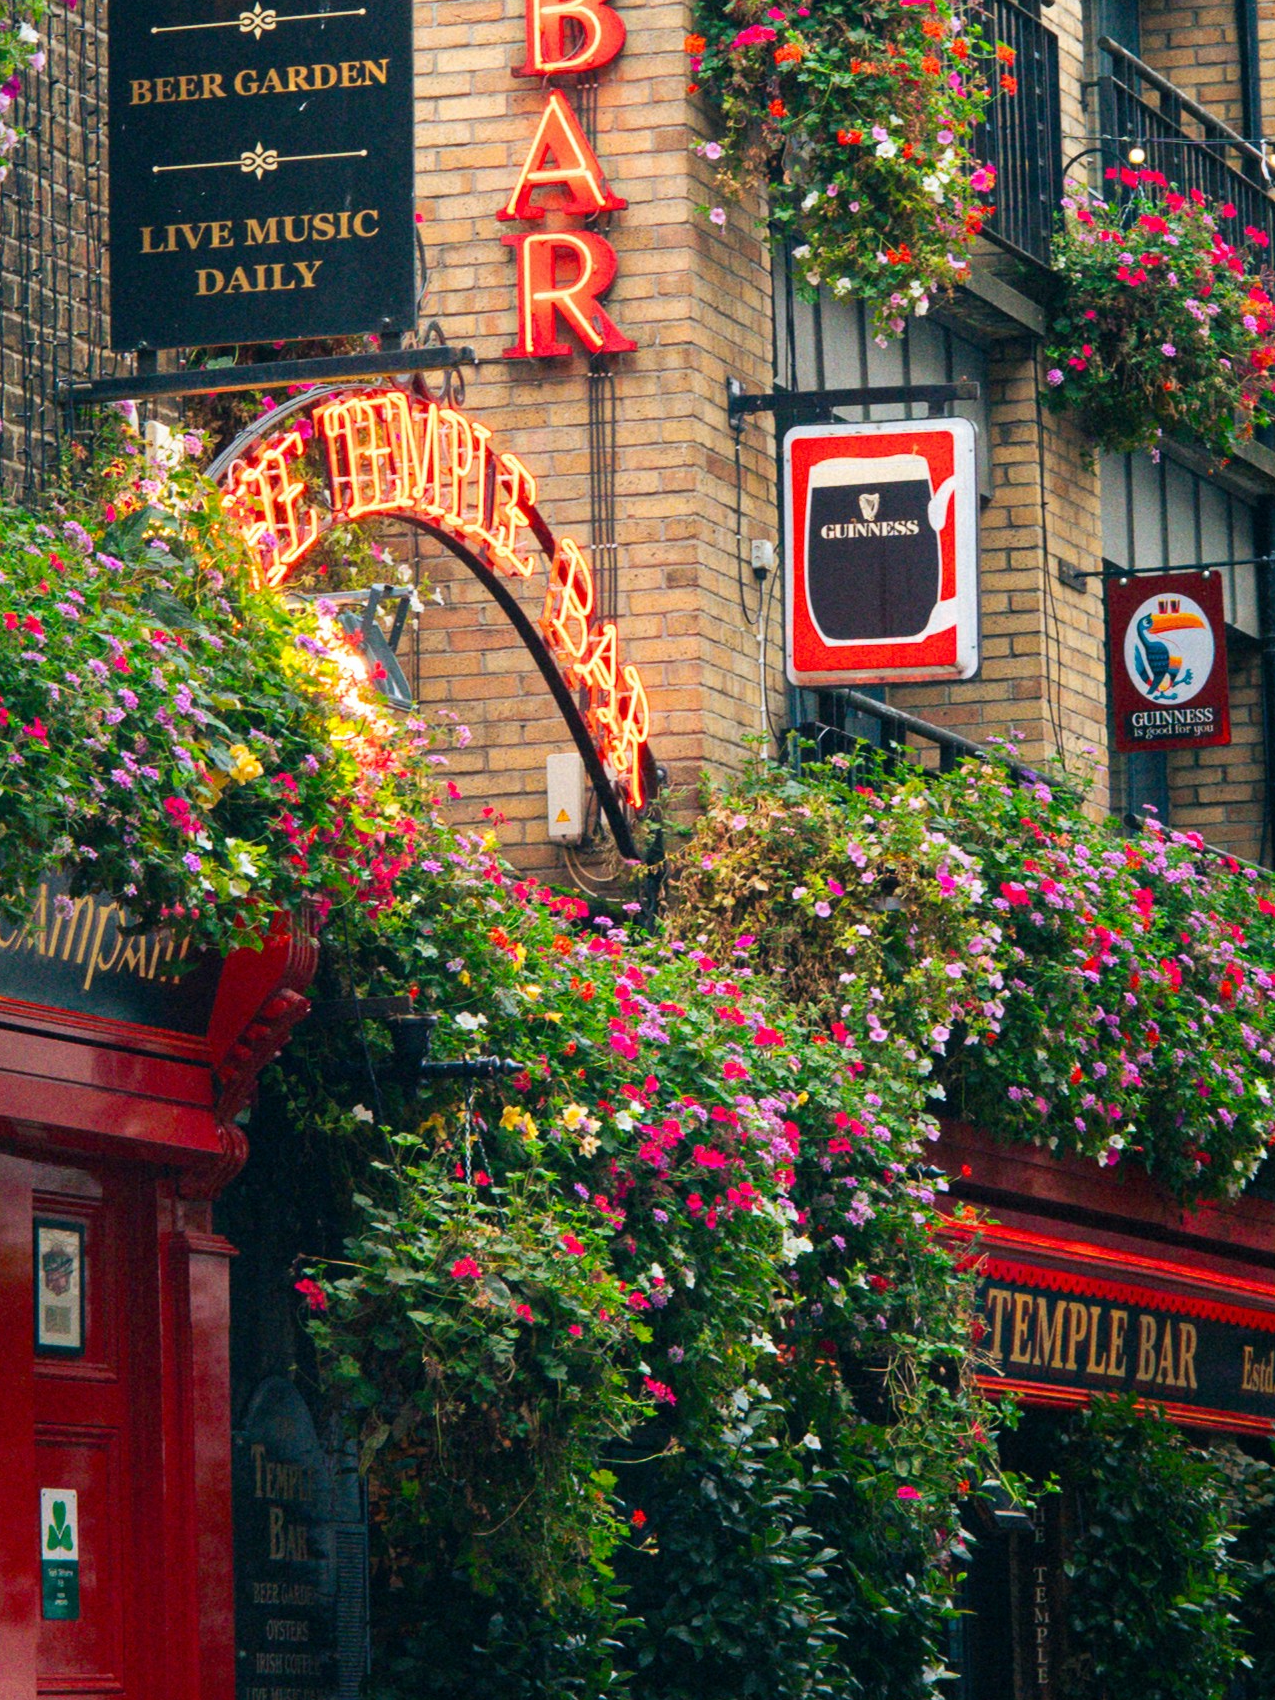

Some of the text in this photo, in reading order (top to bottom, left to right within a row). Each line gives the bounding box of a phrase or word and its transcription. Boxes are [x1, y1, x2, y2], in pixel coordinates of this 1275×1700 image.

[129, 58, 389, 105] BEER GARDEN
[140, 209, 380, 254] LIVE MUSIC
[195, 260, 324, 297] DAILY
[820, 518, 920, 541] GUINNESS
[312, 391, 652, 809] TEMPLE BAR
[1131, 707, 1215, 728] GUINNESS
[1133, 722, 1216, 740] is good for you
[987, 1287, 1130, 1378] TEMPLE
[1135, 1314, 1199, 1390] BAR
[253, 1581, 280, 1604] BEER
[266, 1619, 308, 1642] OYSTERS
[1032, 1565, 1050, 1684] TEMPLE
